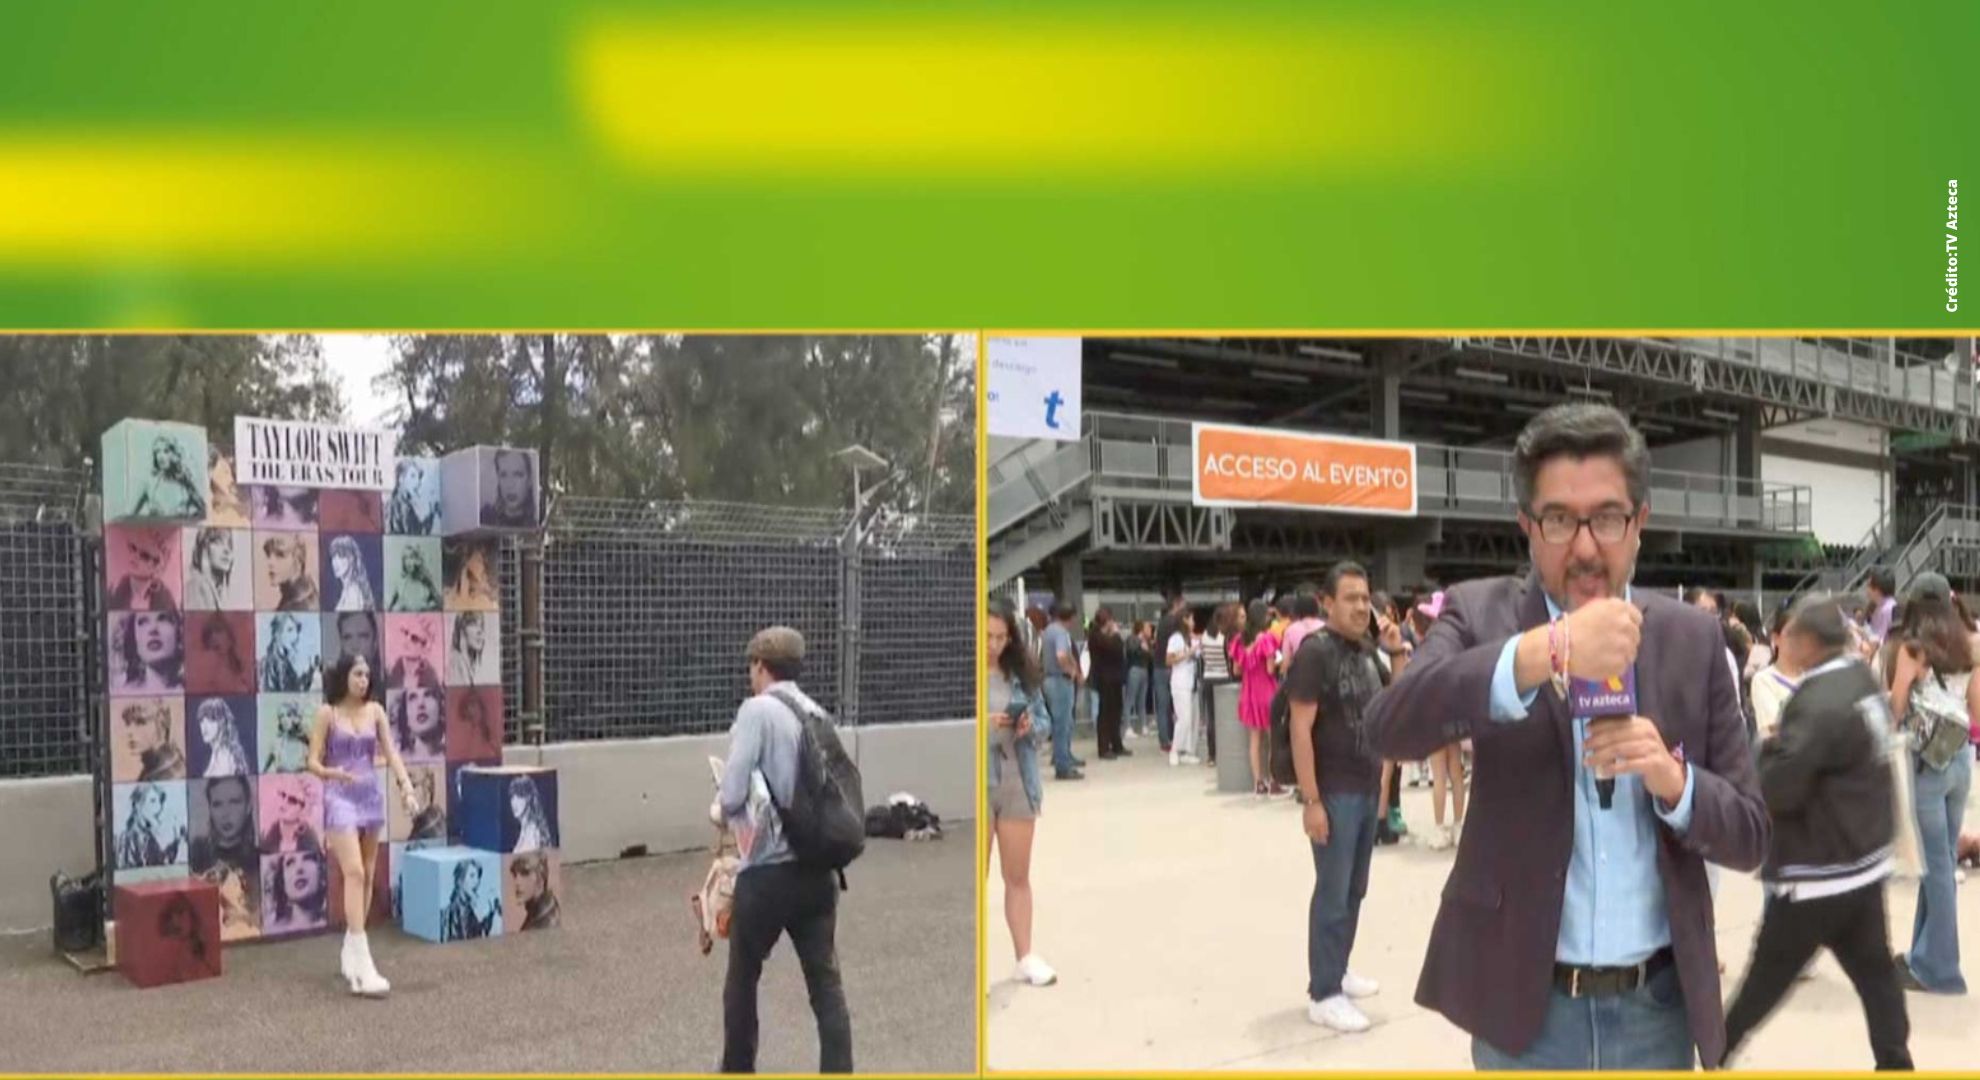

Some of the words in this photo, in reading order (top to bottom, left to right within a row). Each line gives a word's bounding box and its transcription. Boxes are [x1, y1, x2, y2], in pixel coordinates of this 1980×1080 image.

[247, 423, 321, 463] TAYLOR
[327, 431, 382, 466] SWIFT
[249, 461, 285, 480] THE
[290, 463, 335, 483] ERAS
[340, 467, 384, 487] TOUR
[1204, 452, 1297, 481] ACCESO
[1303, 459, 1325, 484] AL
[1330, 462, 1408, 490] EVENTO
[1579, 695, 1591, 707] tv
